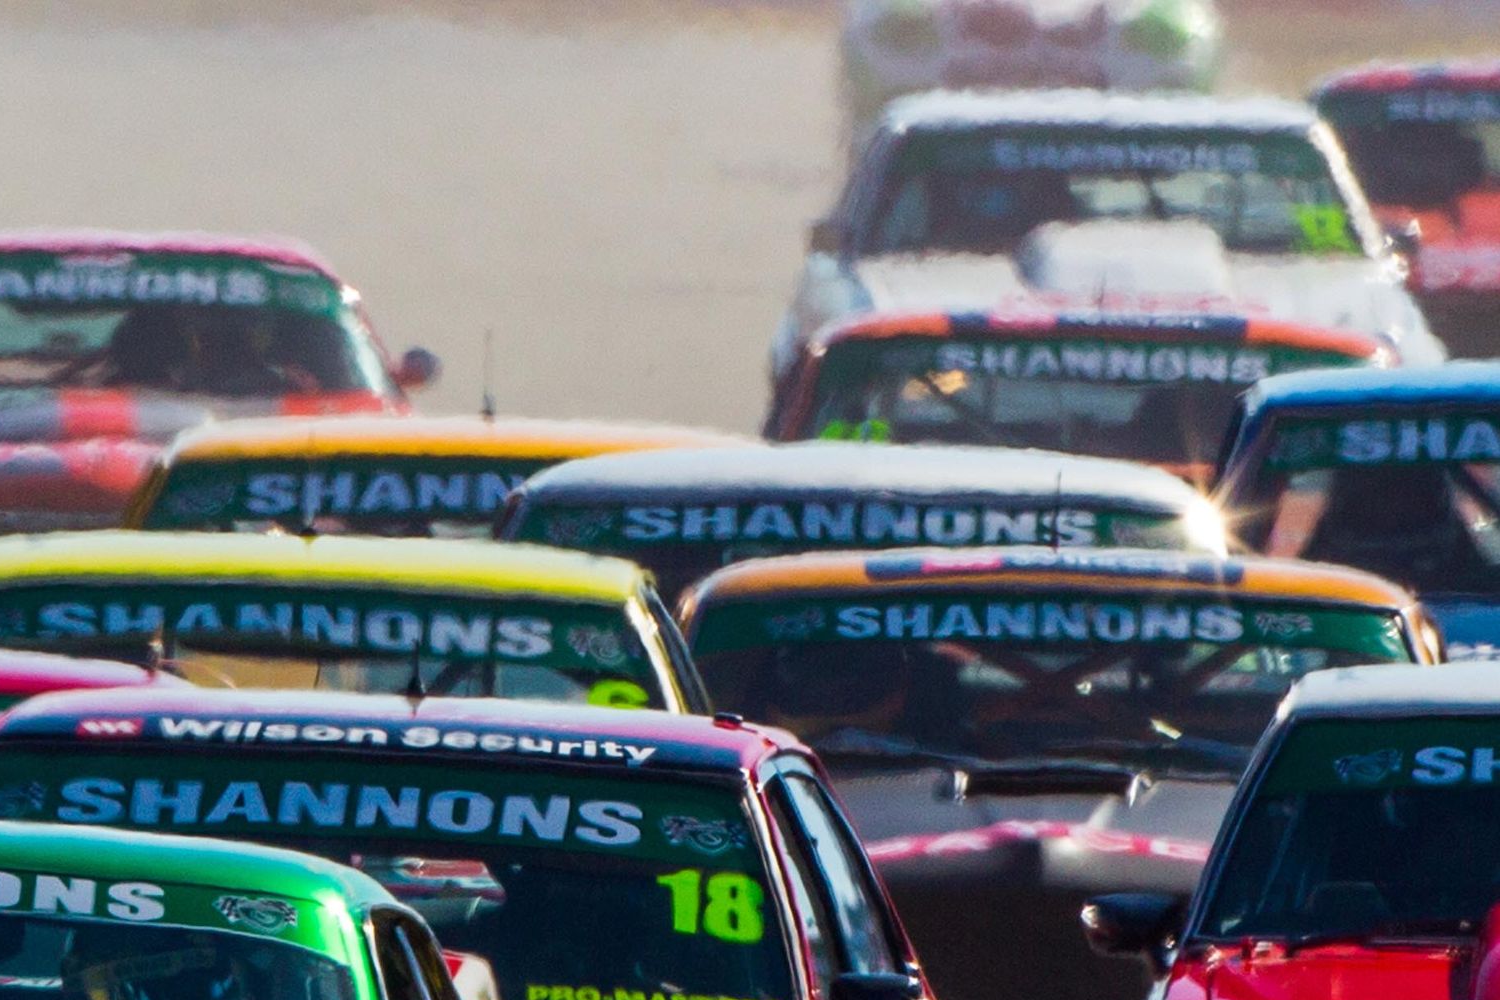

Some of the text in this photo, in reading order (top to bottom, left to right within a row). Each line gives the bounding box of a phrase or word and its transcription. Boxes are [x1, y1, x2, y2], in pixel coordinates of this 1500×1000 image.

[935, 342, 1270, 382] SHANNONS
[623, 504, 1098, 548] SHANNONS
[36, 602, 554, 658] SHANNONS
[834, 605, 1245, 642] SHANNONS
[159, 716, 657, 768] Wilson Security
[57, 777, 644, 846] SHANNONS
[656, 868, 764, 945] 18
